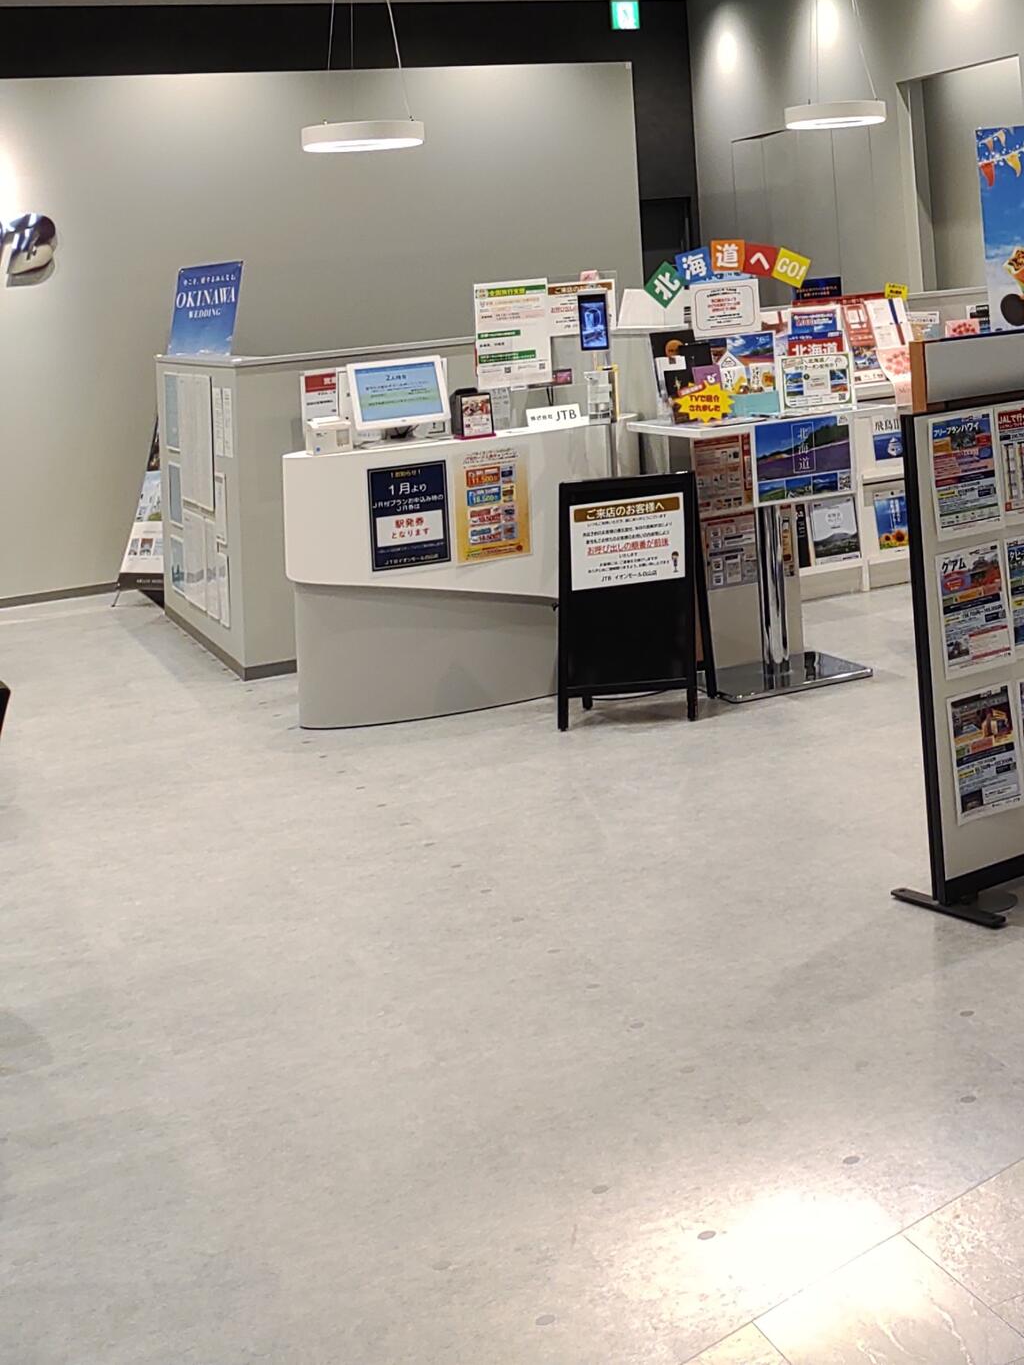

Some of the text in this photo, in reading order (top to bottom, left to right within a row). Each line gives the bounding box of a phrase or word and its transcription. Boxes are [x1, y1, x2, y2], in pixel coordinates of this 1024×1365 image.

[176, 286, 236, 309] OKINAWA
[188, 308, 221, 319] WEDDING
[556, 409, 577, 422] JTB
[586, 502, 665, 520] ご来店のお客様へ
[941, 557, 967, 574] グアム
